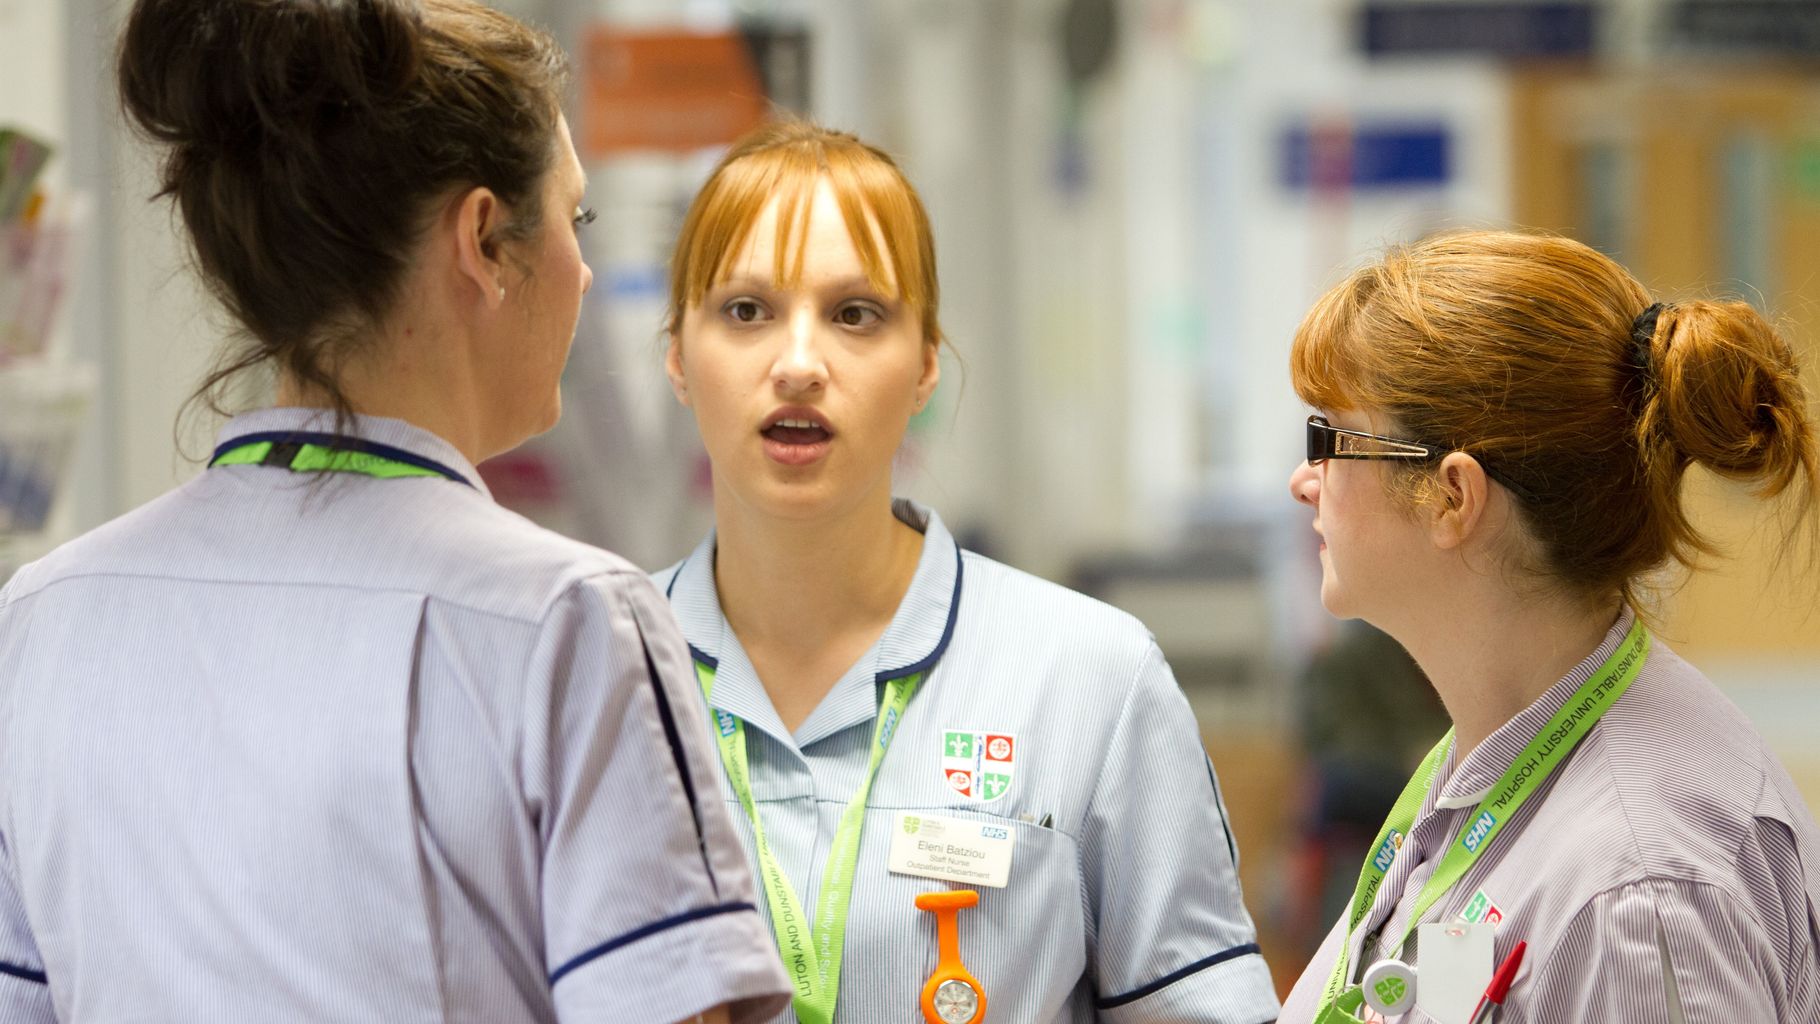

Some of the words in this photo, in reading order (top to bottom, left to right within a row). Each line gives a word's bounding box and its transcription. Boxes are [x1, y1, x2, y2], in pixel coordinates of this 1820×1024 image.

[1593, 648, 1638, 700] DUNSTABLE
[717, 708, 736, 737] NH
[1537, 697, 1597, 761] UNIVERSITY
[1491, 758, 1540, 809] HOSPITAL
[982, 826, 1008, 840] NHS
[1463, 811, 1495, 852] NHS
[918, 840, 944, 853] Eleni
[946, 844, 986, 860] Batziou
[929, 854, 947, 863] Staff
[906, 860, 946, 874] Outpatient
[946, 865, 990, 880] Department
[1350, 875, 1380, 929] HOSPITAL
[787, 925, 803, 951] AND
[794, 953, 812, 998] LUTON
